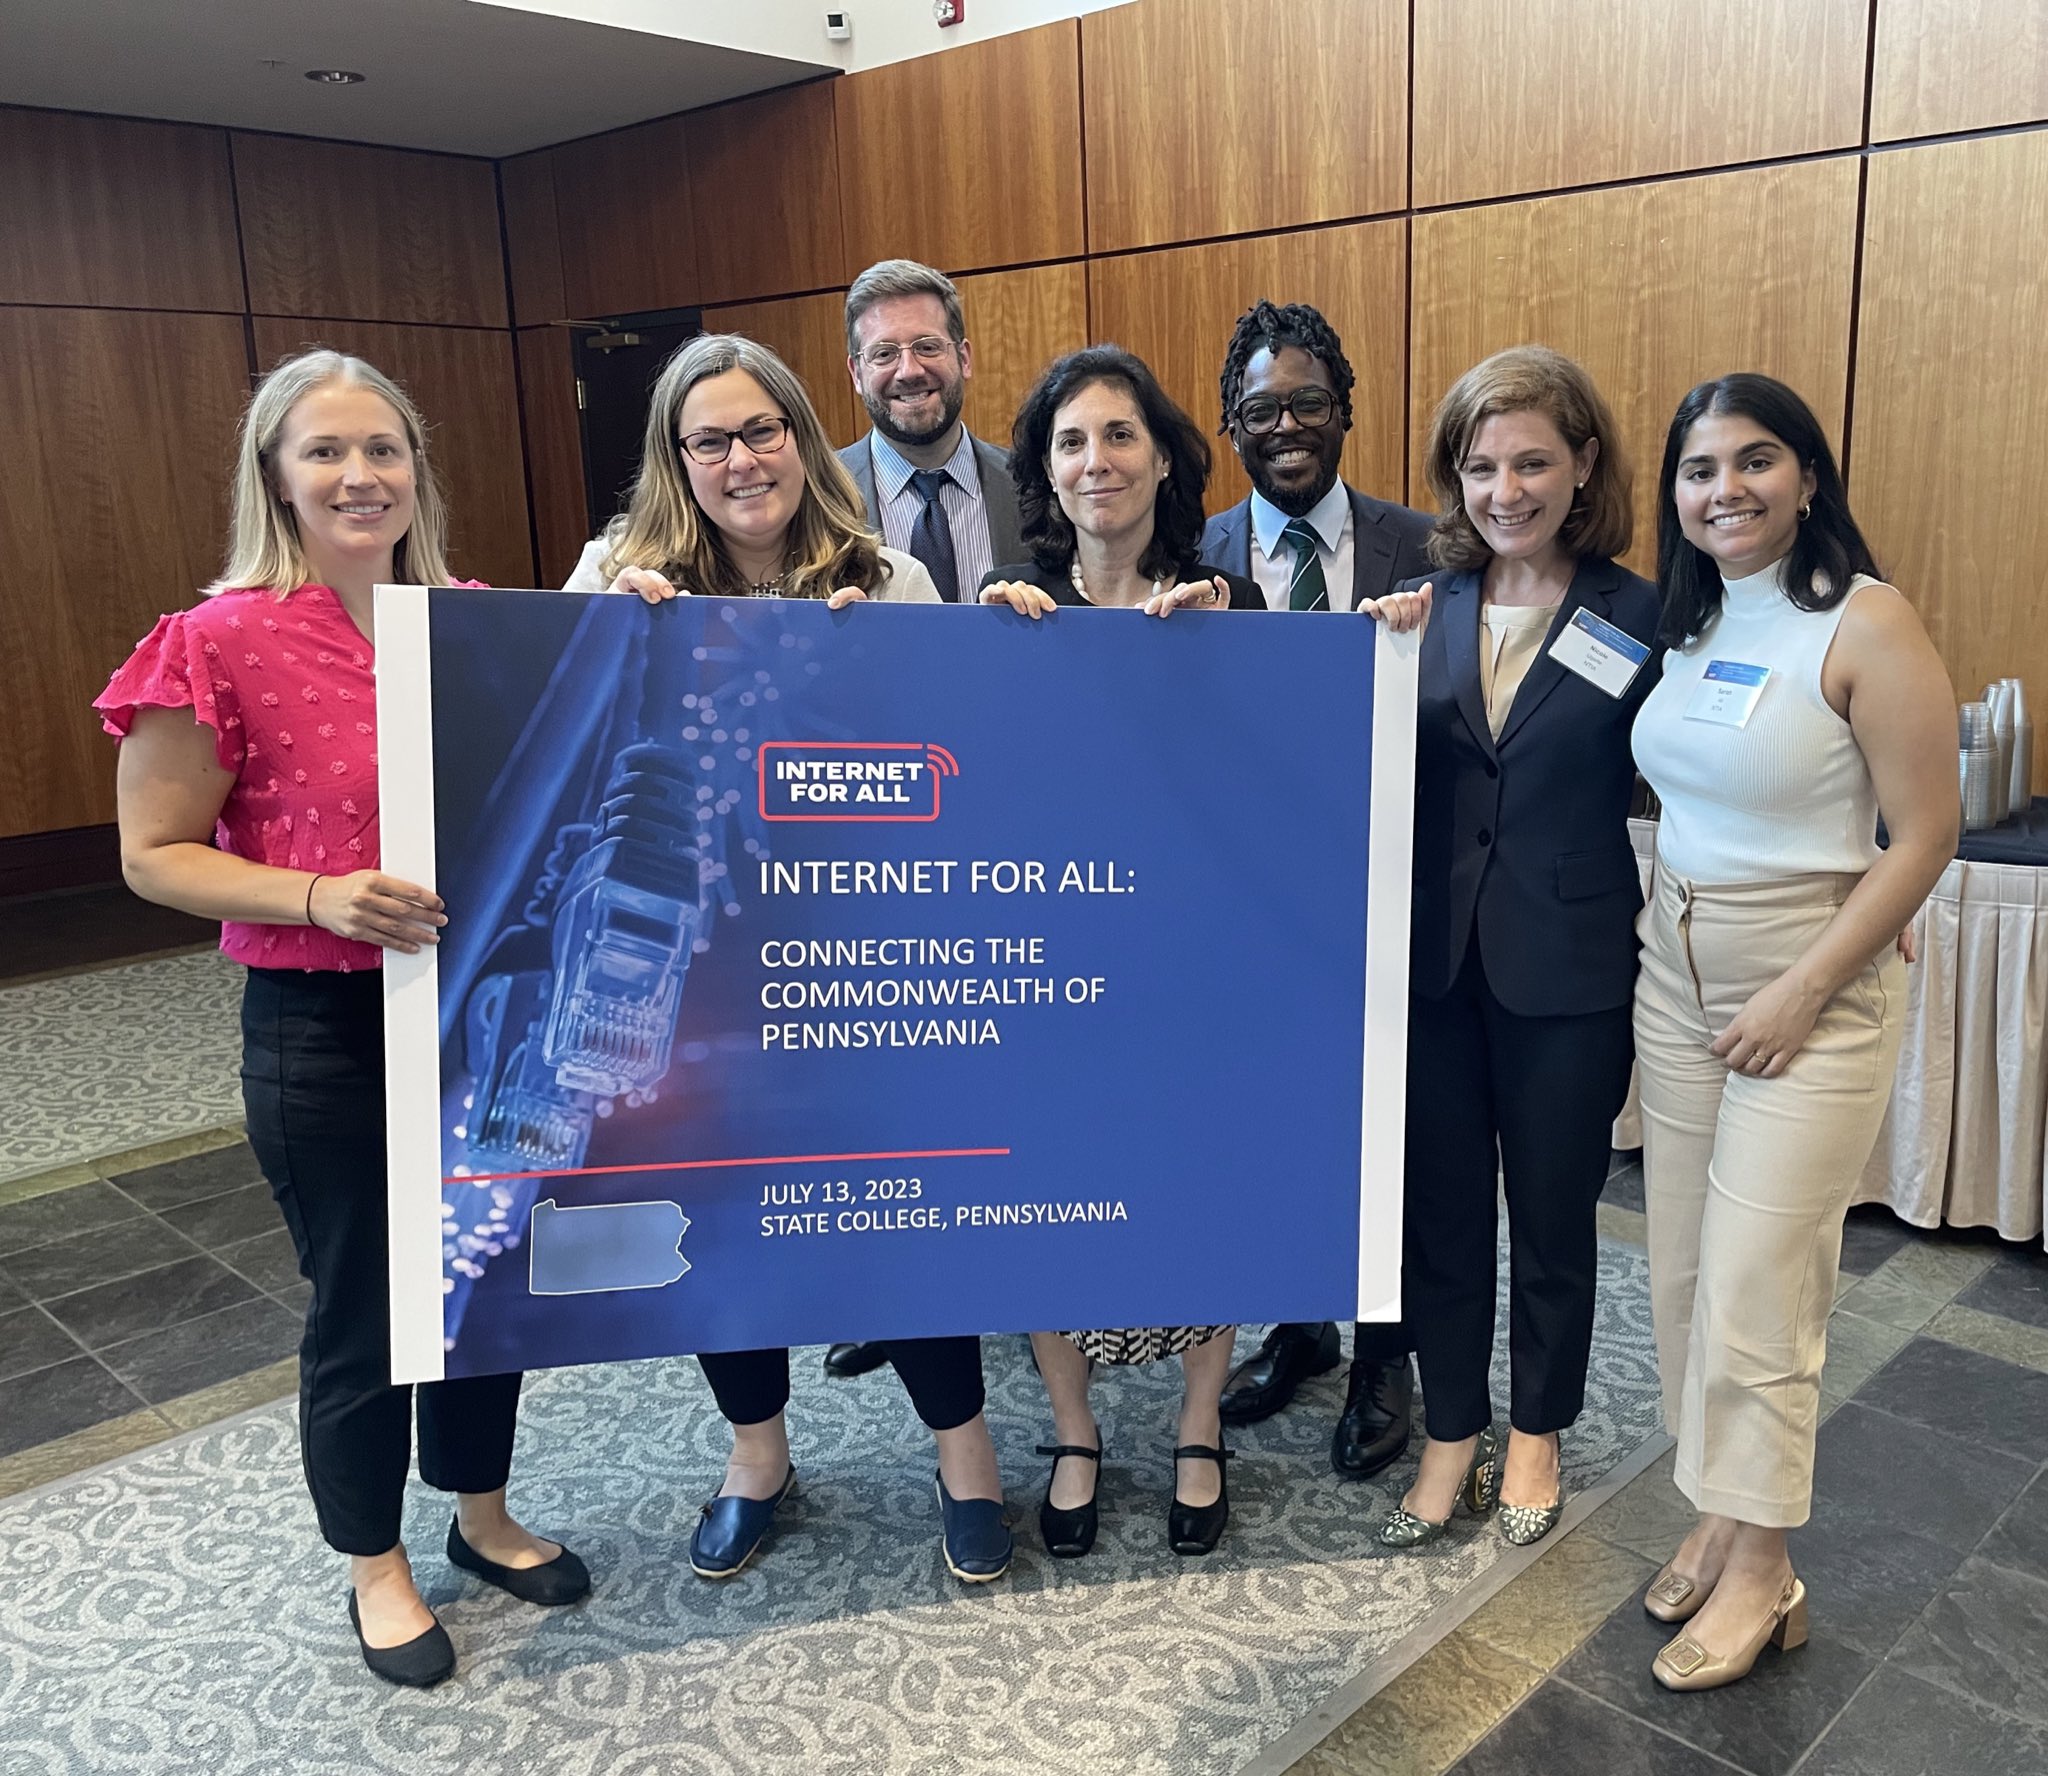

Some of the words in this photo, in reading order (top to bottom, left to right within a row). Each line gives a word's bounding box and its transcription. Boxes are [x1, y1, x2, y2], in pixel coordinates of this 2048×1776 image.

[776, 761, 924, 781] INTERNET
[790, 783, 848, 803] FOR
[854, 783, 911, 803] ALL
[761, 860, 959, 895] INTERNET
[971, 860, 1047, 894] FOR
[1058, 860, 1136, 893] ALL:
[760, 938, 975, 968] CONNECTING
[984, 937, 1045, 964] THE
[761, 977, 1054, 1009] COMMONWEALTH
[1065, 977, 1106, 1004] OF
[762, 1018, 1001, 1051] PENNSYLVANIA
[760, 1182, 814, 1206] JULY
[822, 1181, 857, 1205] 13,
[864, 1177, 922, 1201] 2023
[760, 1212, 830, 1237] STATE
[837, 1207, 948, 1233] COLLEGE,
[956, 1201, 1128, 1227] PENNSYLVANIA
